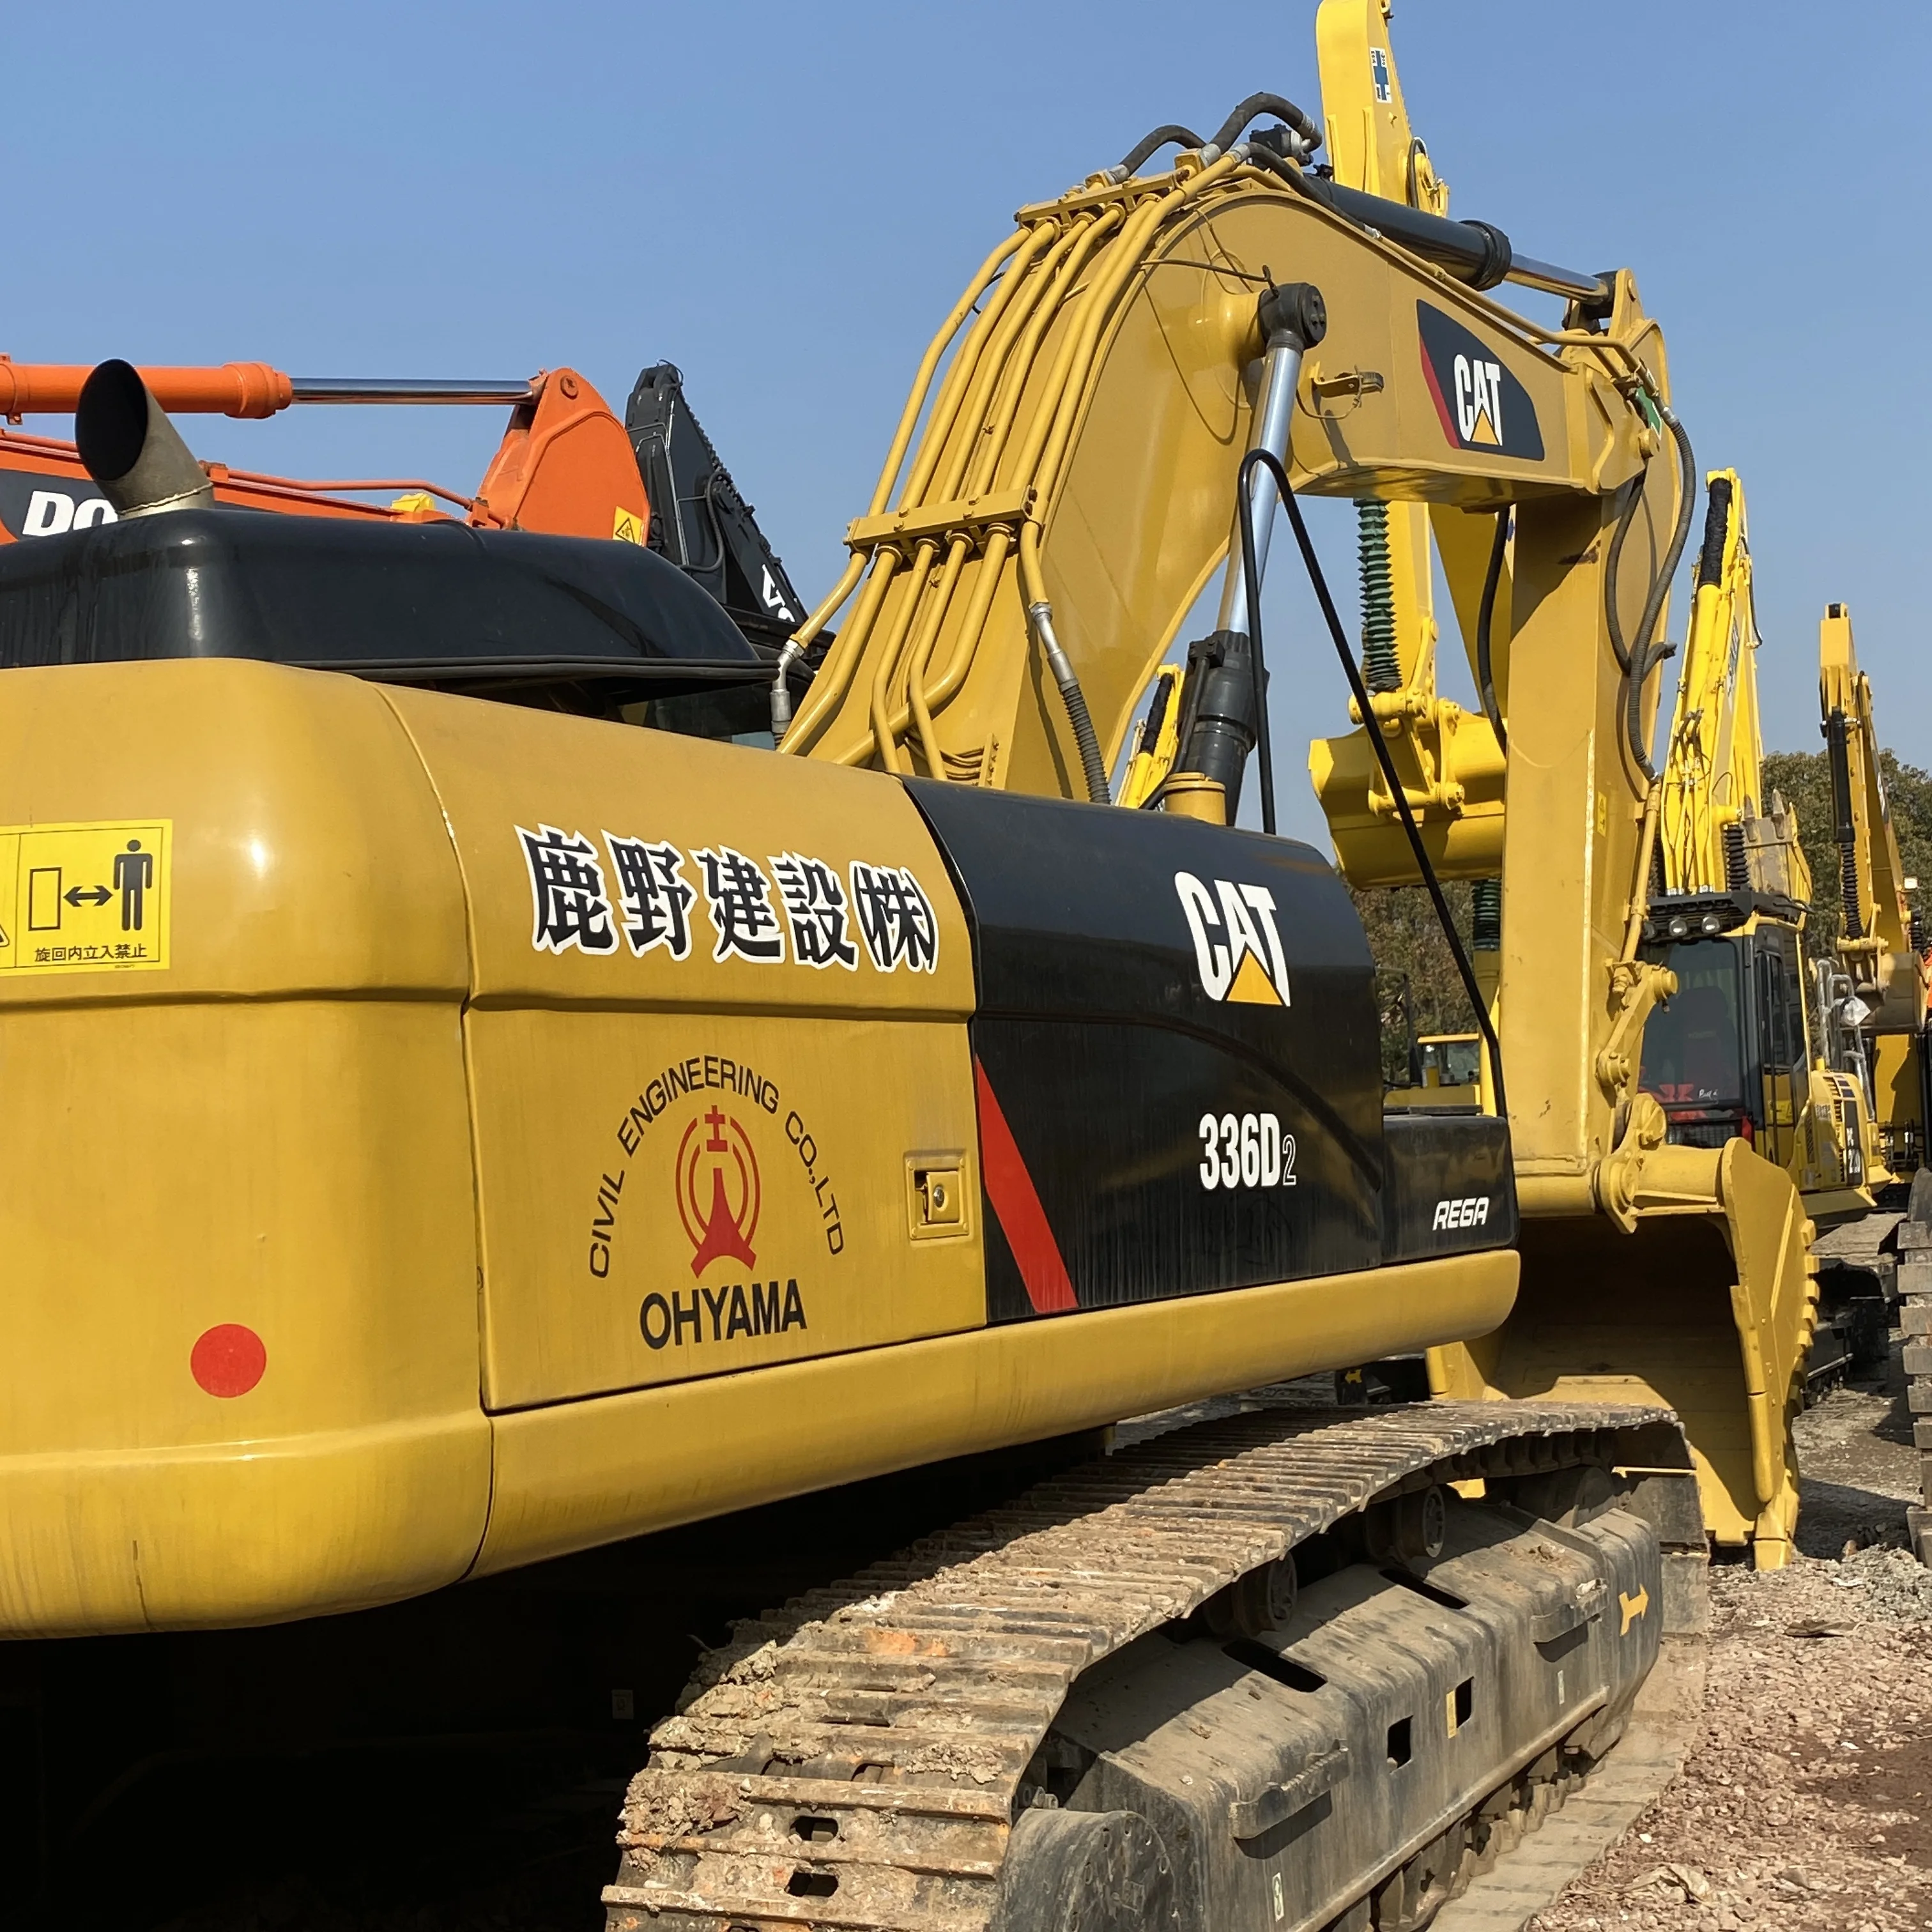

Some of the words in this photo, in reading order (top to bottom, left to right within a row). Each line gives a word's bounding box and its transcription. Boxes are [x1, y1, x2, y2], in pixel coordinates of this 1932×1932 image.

[1454, 354, 1503, 446] CAT
[34, 943, 148, 962] 旋回内立入禁止
[1175, 871, 1291, 1007] CAT
[589, 1169, 625, 1278] CIVIL
[617, 1055, 779, 1158] ENGINEERING
[1199, 1113, 1296, 1190] 336D2
[1432, 1197, 1490, 1231] REGA
[640, 1278, 808, 1350] OHYAMA
